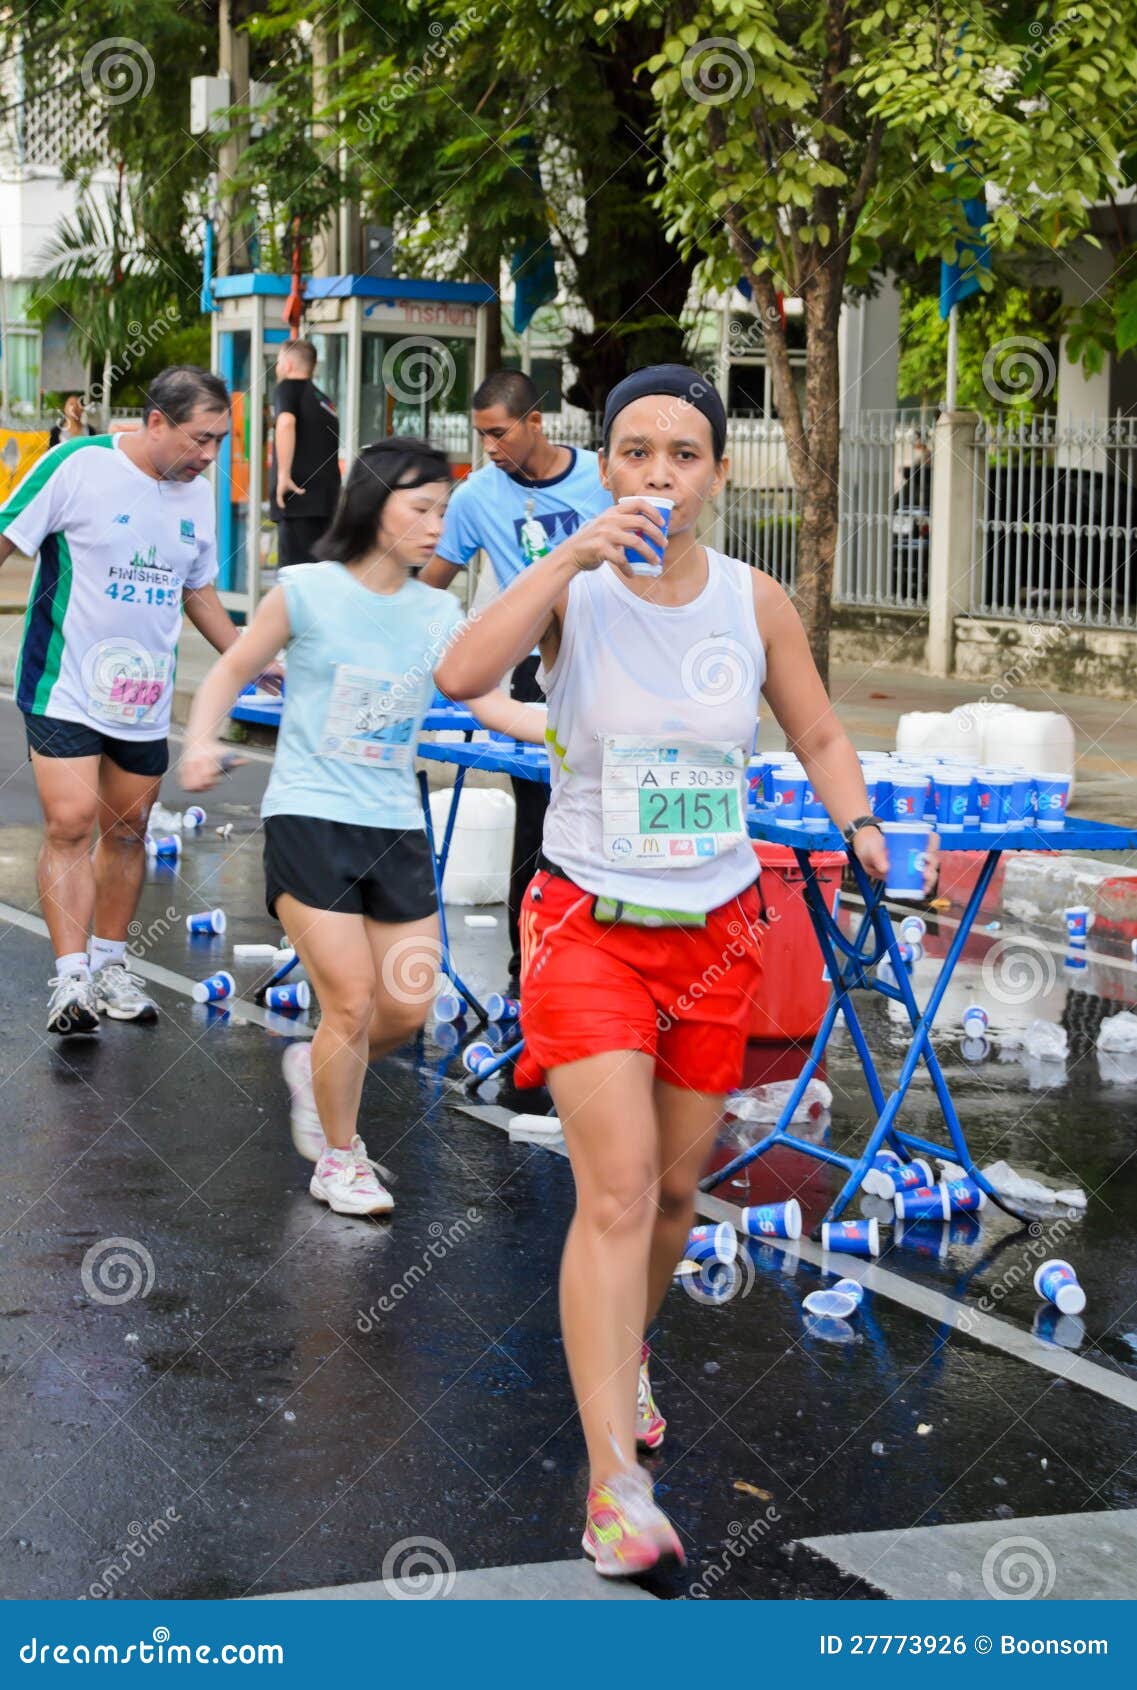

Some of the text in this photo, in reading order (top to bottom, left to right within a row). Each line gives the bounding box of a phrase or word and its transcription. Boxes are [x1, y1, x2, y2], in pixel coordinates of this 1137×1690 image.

[109, 566, 169, 585] FINISHER
[641, 770, 660, 787] A
[670, 771, 681, 785] F
[688, 770, 735, 786] 30-39
[648, 792, 733, 830] 2151
